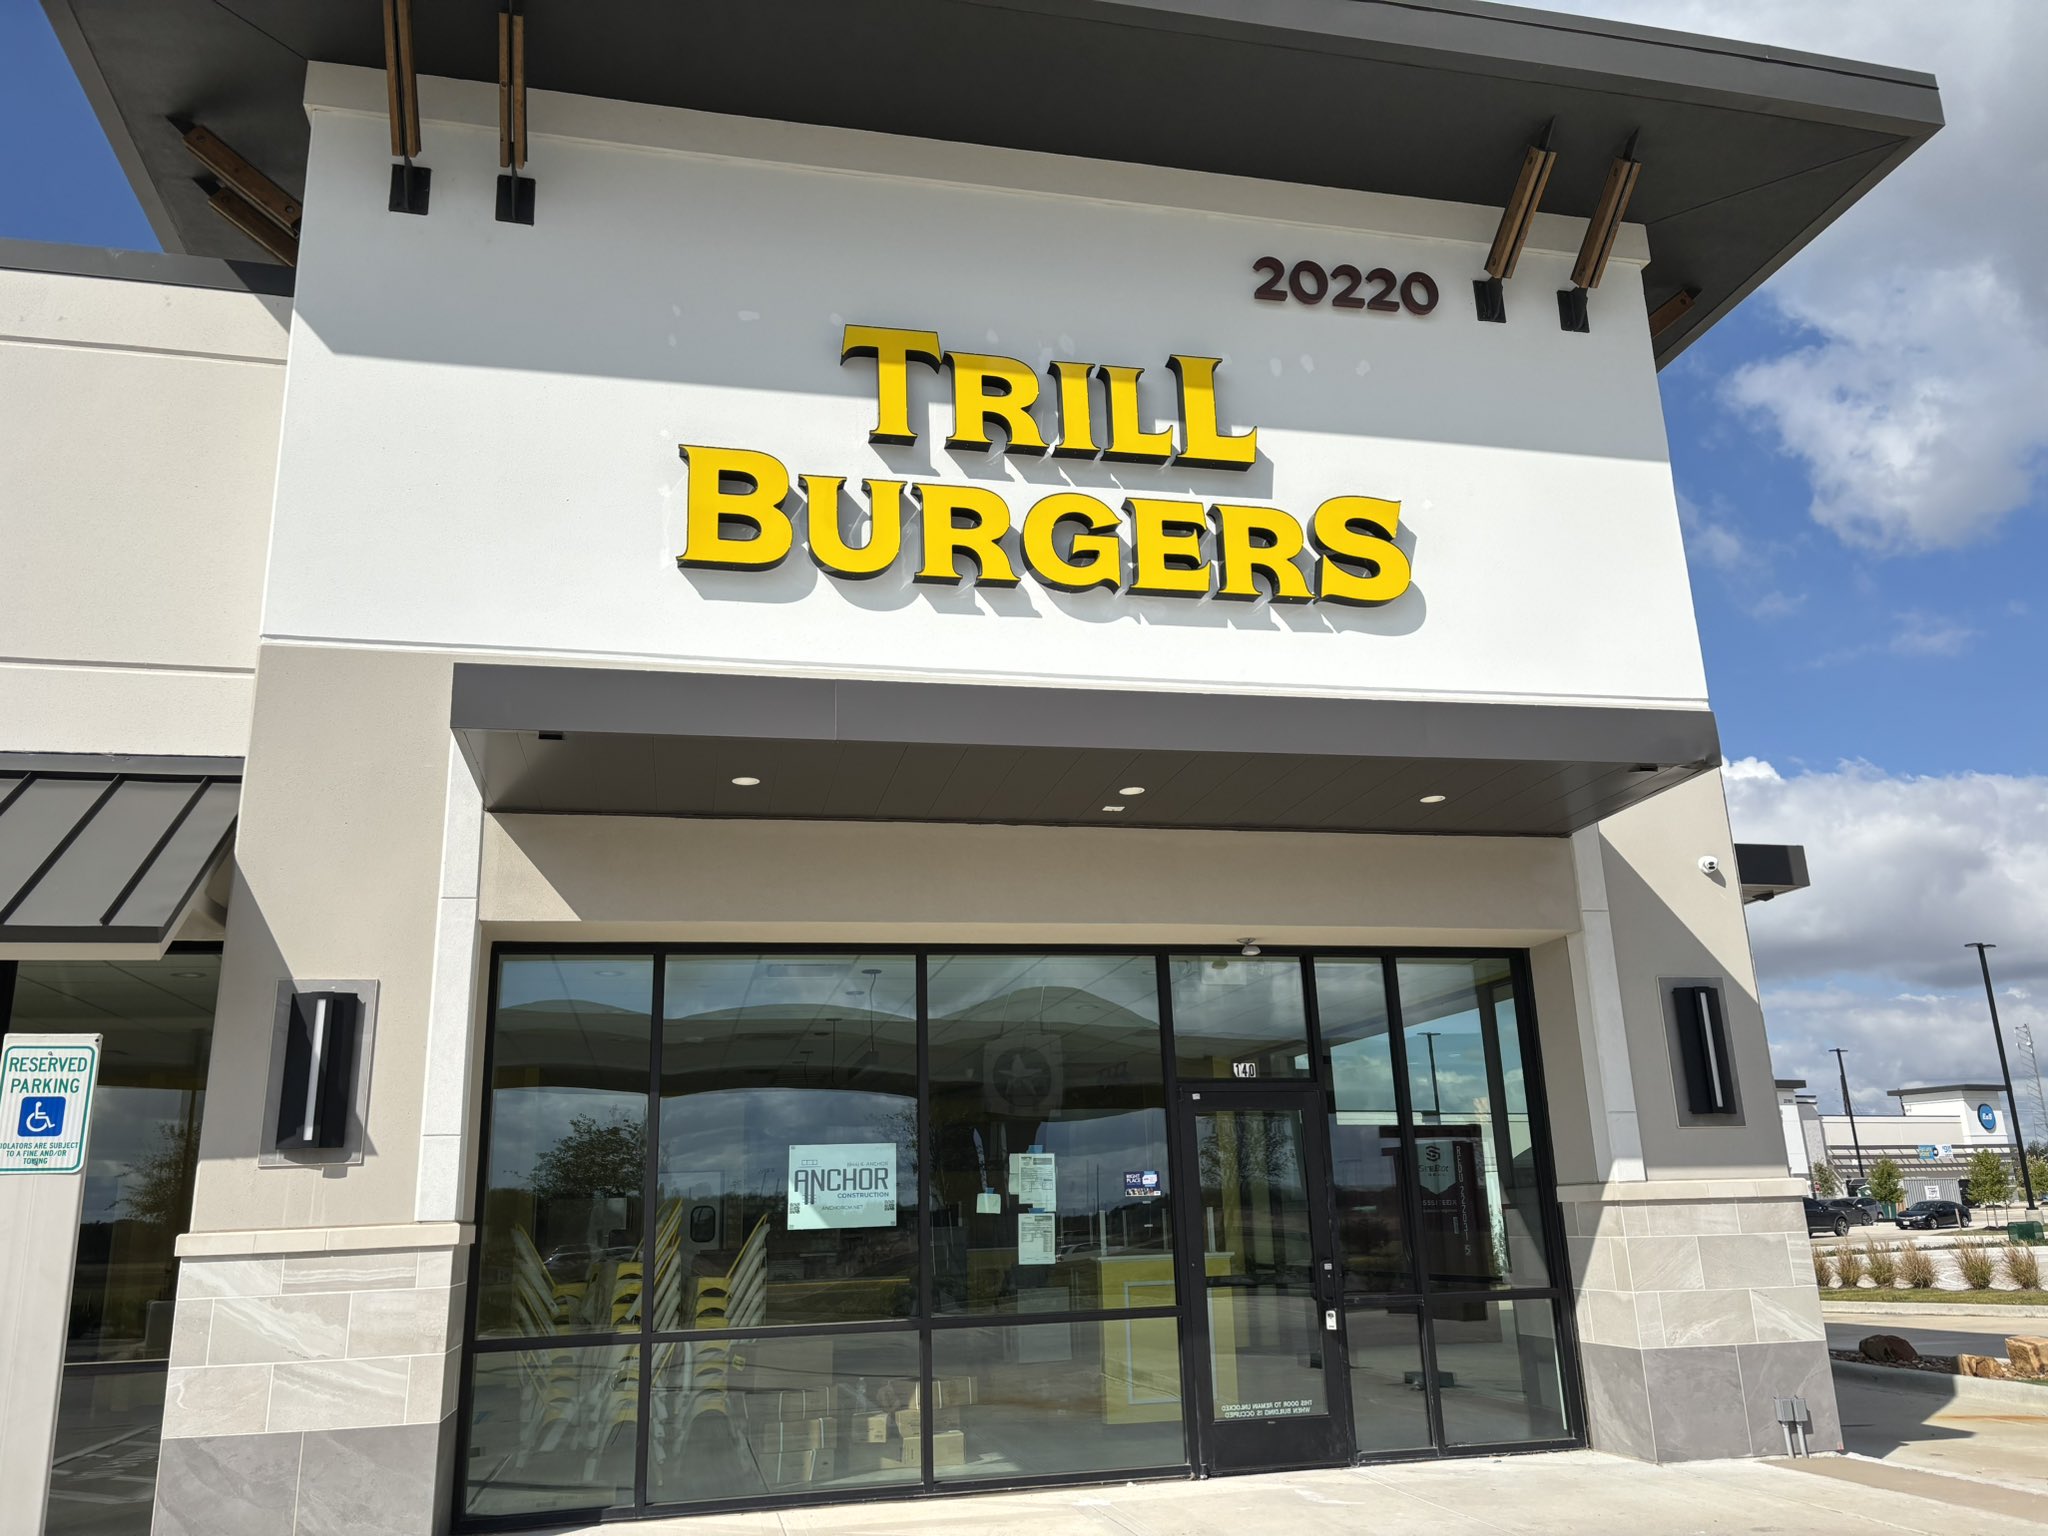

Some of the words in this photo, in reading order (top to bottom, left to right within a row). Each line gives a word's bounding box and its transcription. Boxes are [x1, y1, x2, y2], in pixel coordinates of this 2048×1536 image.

[1252, 256, 1440, 316] 20220
[840, 324, 1258, 472] TRILL
[675, 444, 1412, 608] BURGERS
[9, 1057, 88, 1072] RESERVED
[1235, 1064, 1255, 1077] 140
[10, 1078, 81, 1094] PARKING
[794, 1168, 889, 1205] ANCHOR
